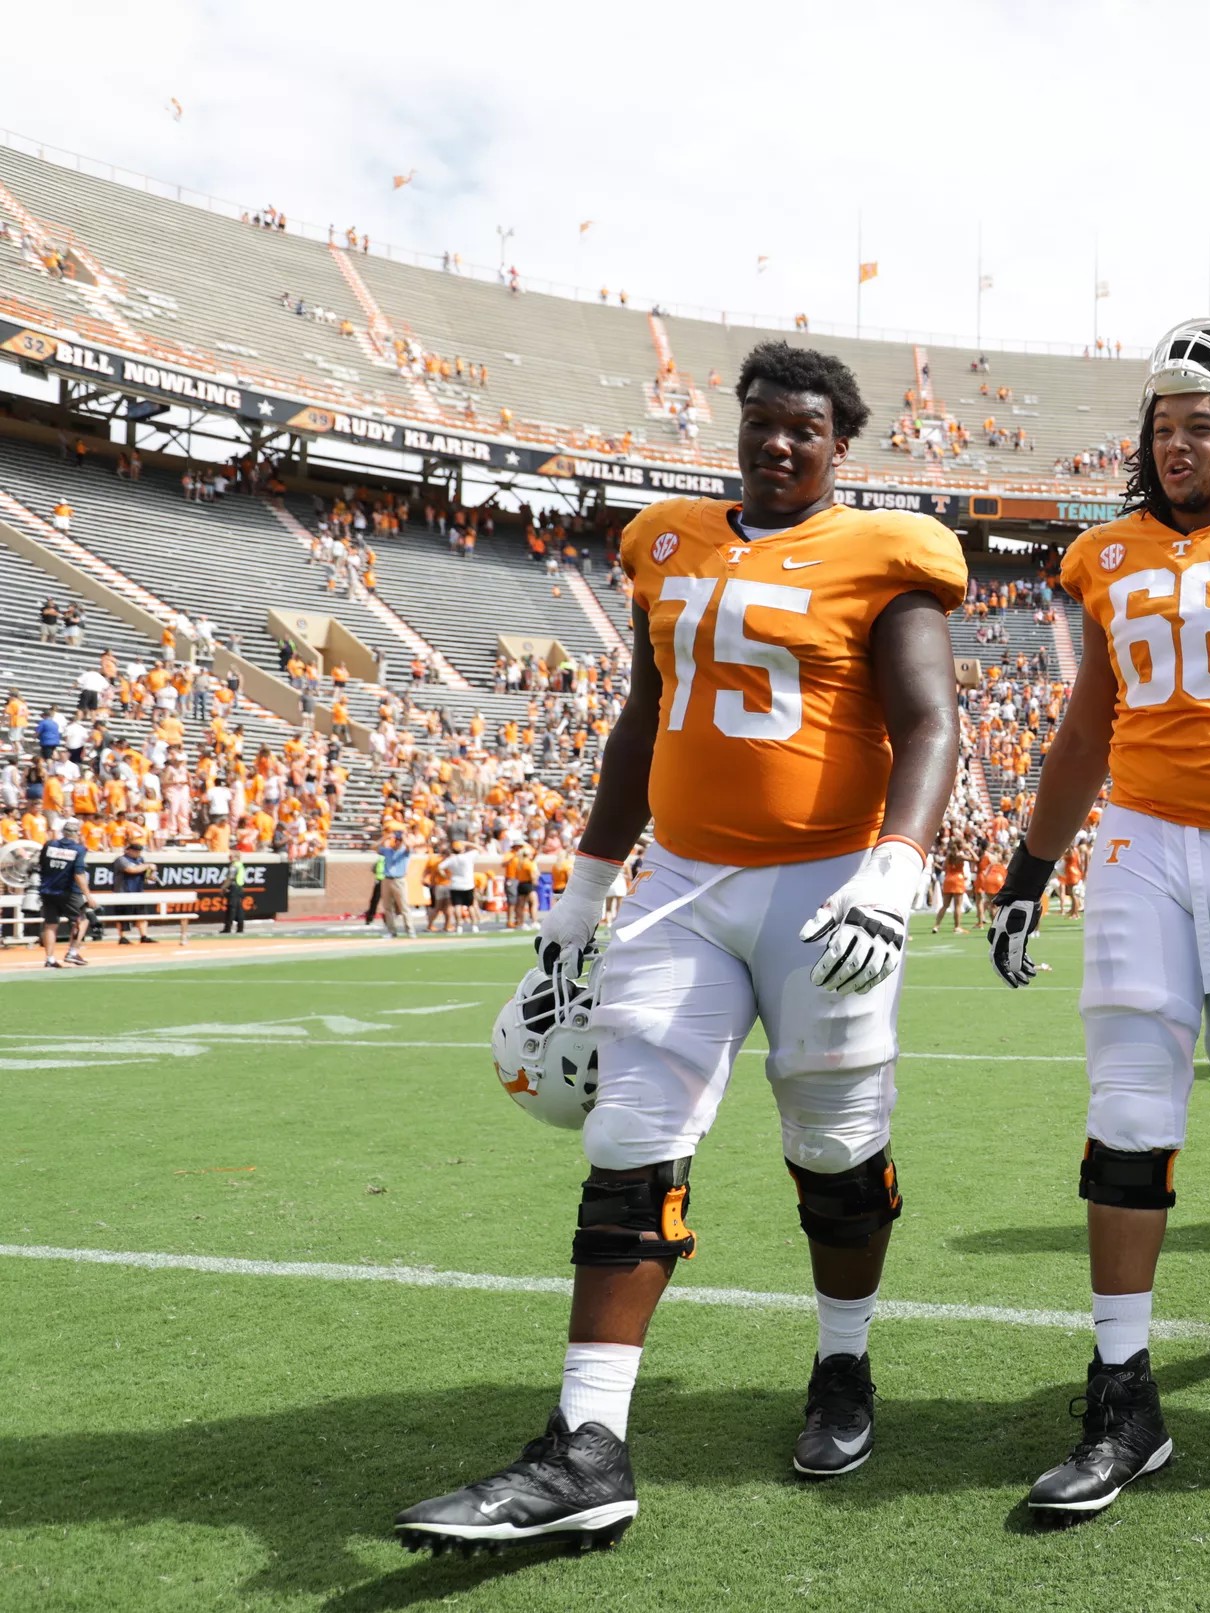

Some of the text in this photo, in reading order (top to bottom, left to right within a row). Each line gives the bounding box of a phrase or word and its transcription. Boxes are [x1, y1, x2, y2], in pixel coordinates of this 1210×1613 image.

[24, 336, 241, 409] 32 BILL NOWLING
[334, 412, 396, 442] RUDY
[404, 428, 490, 461] KLARER
[575, 459, 644, 485] WILLIS
[649, 470, 725, 494] TUCKER
[862, 491, 920, 510] FUSON
[1057, 502, 1124, 520] TENNE
[654, 532, 679, 562] SEC
[1100, 544, 1124, 571] SEC
[659, 576, 812, 740] 75
[1102, 838, 1131, 866] T
[161, 866, 266, 885] INSURCE
